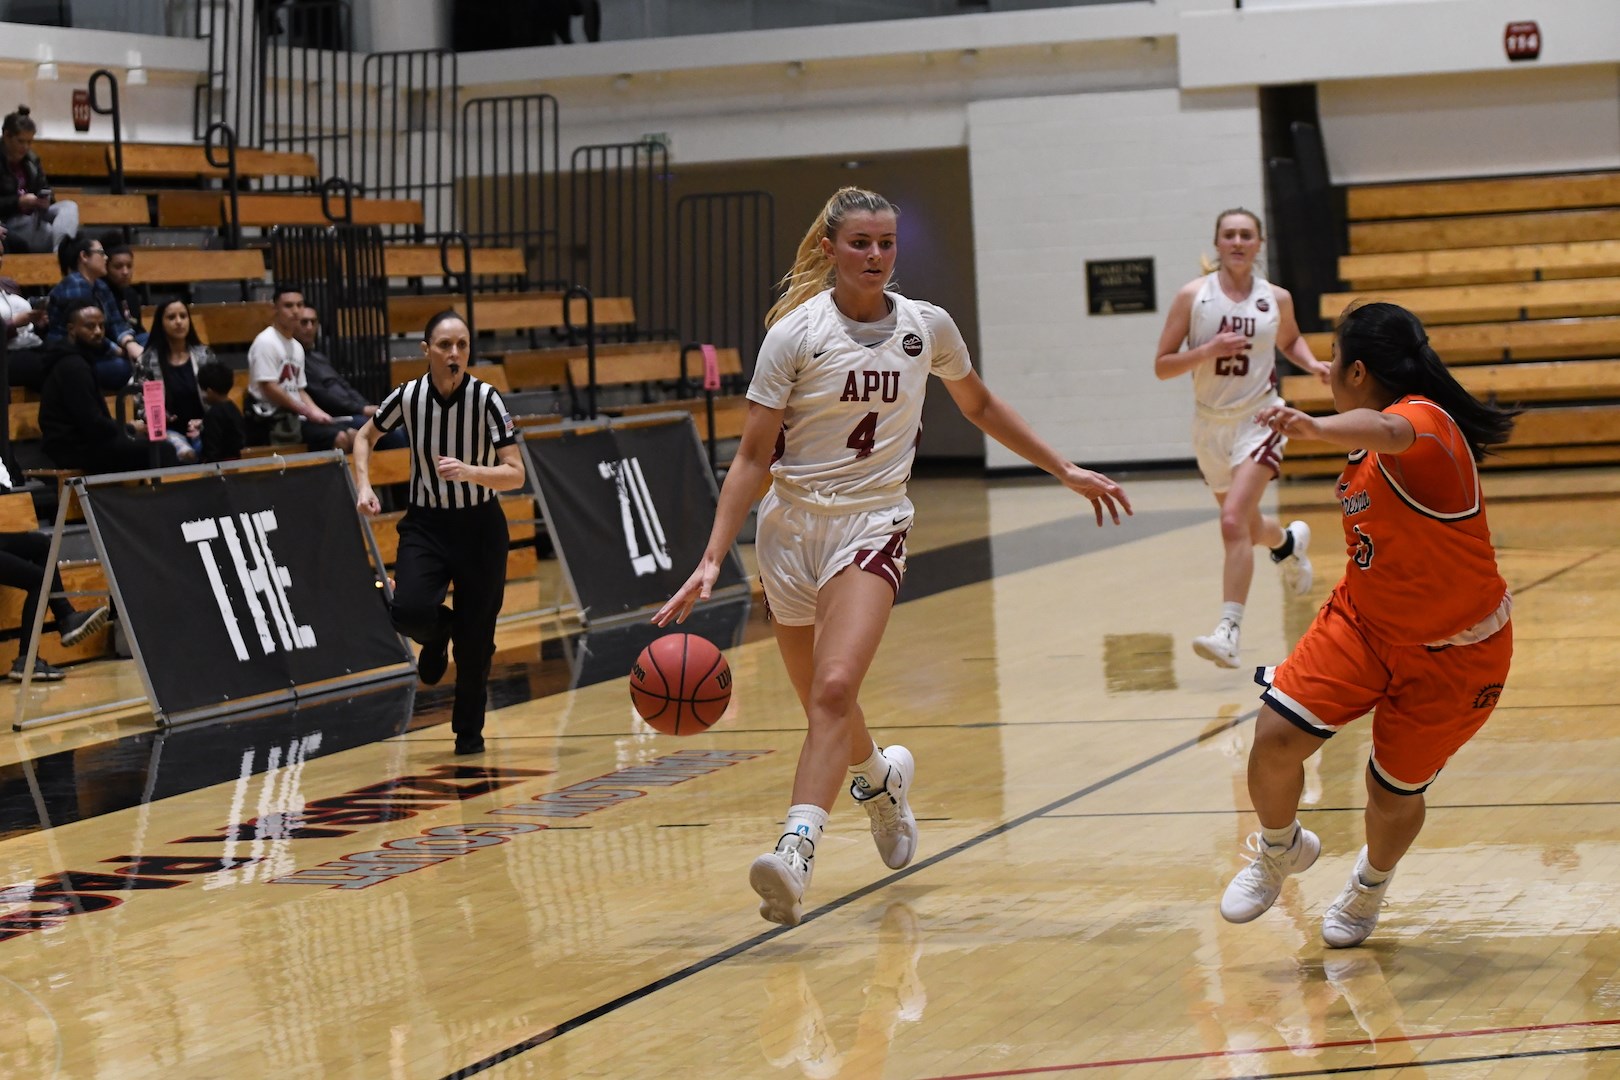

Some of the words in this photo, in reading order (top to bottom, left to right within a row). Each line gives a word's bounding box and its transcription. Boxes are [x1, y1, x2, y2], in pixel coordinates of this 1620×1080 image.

[1217, 315, 1256, 337] APU
[840, 370, 900, 403] APU
[846, 411, 879, 459] 4
[180, 508, 318, 662] THE
[166, 765, 557, 844] AZUSA
[267, 822, 550, 890] COURT
[0, 855, 269, 942] PAC
